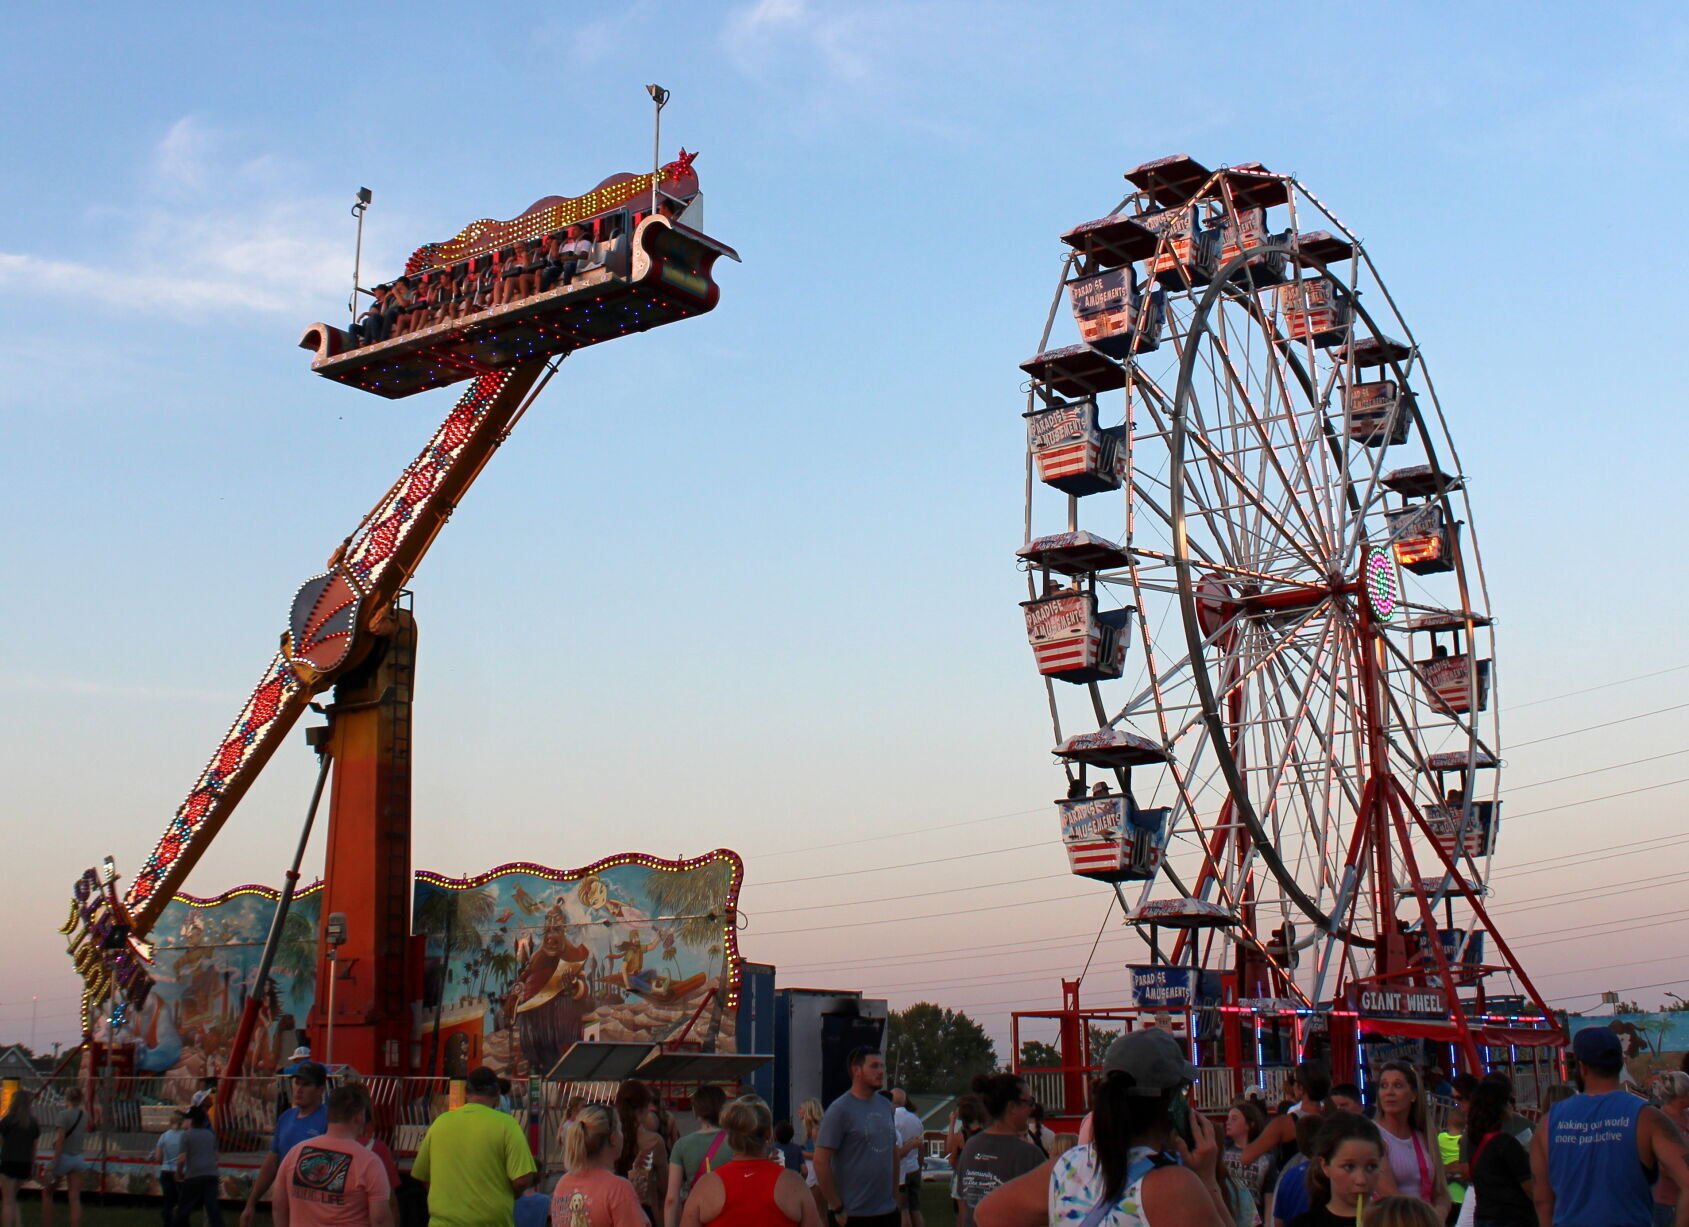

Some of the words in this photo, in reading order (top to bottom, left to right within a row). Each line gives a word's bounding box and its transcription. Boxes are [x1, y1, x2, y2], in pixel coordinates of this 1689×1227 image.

[1073, 278, 1104, 298] PARADSE
[1084, 286, 1128, 307] AMUSEMENTS
[1031, 408, 1067, 437] PARADISE
[1036, 417, 1088, 447] AMUSEMENTS
[1026, 599, 1064, 627] PARADISE
[1135, 971, 1167, 987] PARADSE
[1145, 986, 1191, 1000] AMUSEMENTS
[1361, 991, 1401, 1011] GIANT
[1407, 993, 1443, 1012] WHEEL
[1604, 1116, 1630, 1127] world
[1555, 1134, 1577, 1144] more
[321, 1192, 345, 1206] LIFE
